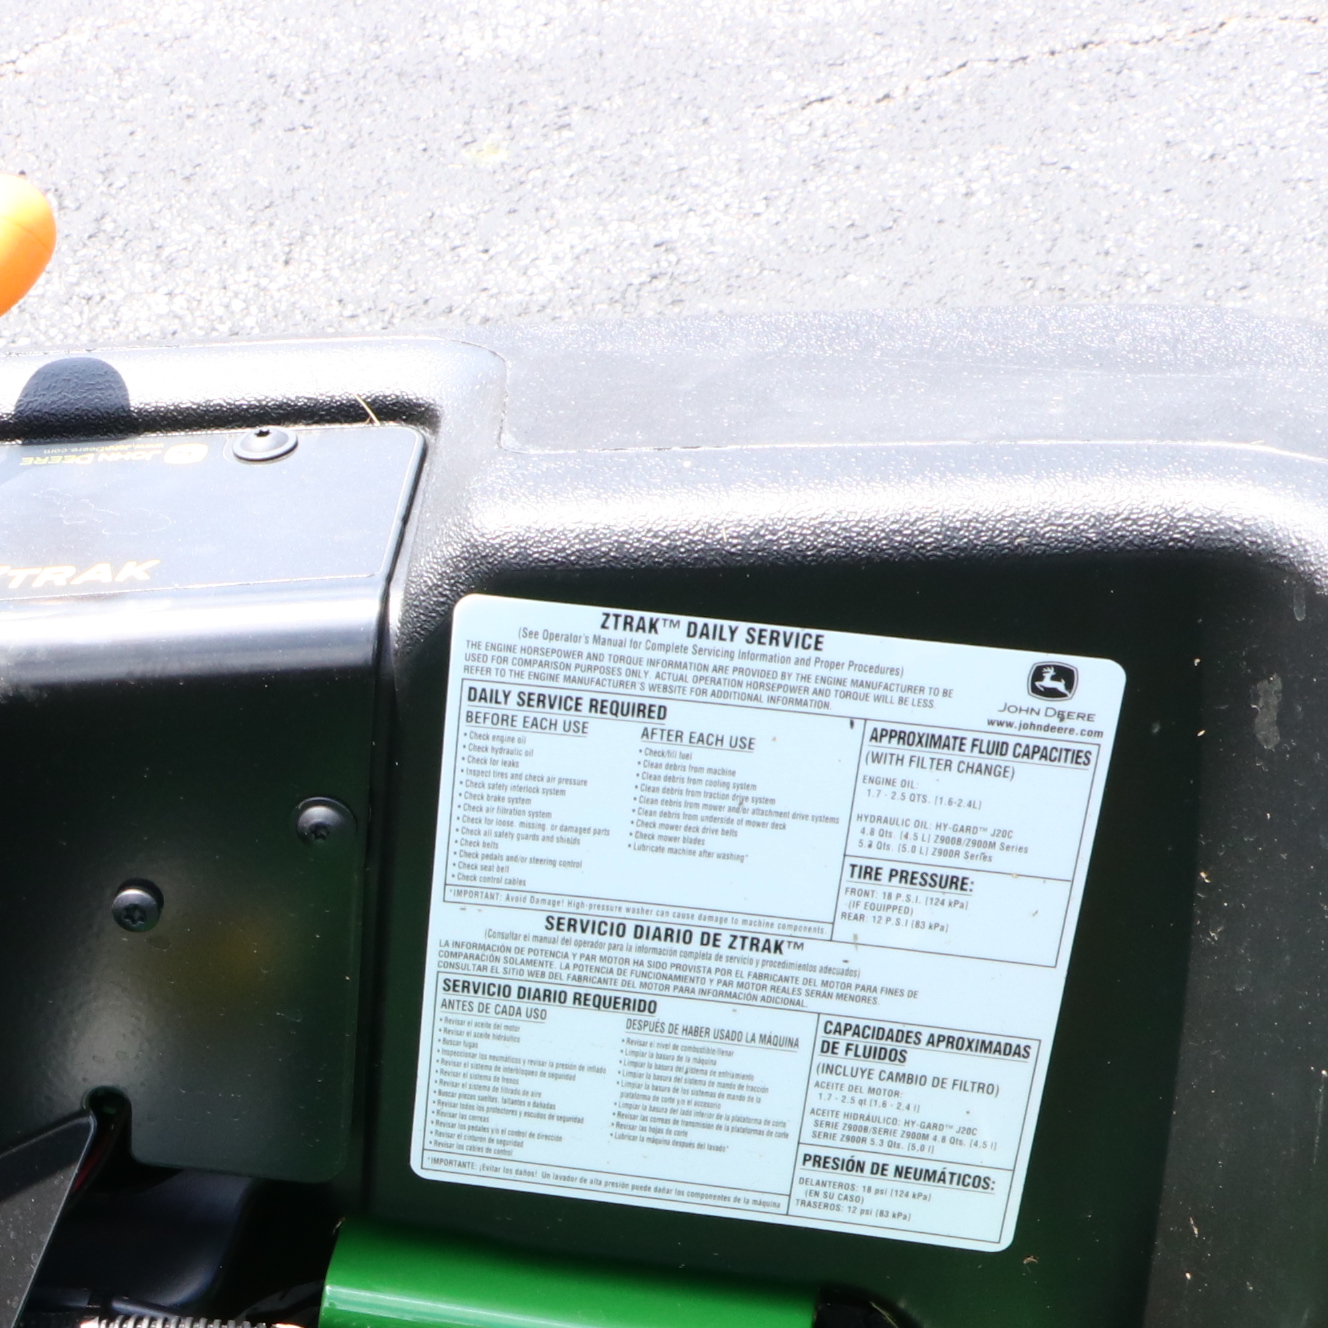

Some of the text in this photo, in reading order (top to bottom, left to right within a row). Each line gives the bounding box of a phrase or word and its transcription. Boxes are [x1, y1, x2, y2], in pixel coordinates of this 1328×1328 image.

[19, 450, 163, 466] JOHN DEERE
[600, 612, 824, 651] ZTRAK™ DAILY SERVICE
[467, 686, 667, 720] DAILY SERVICE REQUIRED
[998, 702, 1095, 722] JOHN DEERE
[465, 710, 588, 734] BEFORE EACH USE
[987, 719, 1104, 738] www.johndeere.com
[469, 730, 526, 744] Check engine oil
[640, 726, 755, 750] AFTER EACH USE
[869, 727, 1092, 766] APPROXIMATE FLUID CAPACITIES
[861, 774, 919, 789] ENGINE OIL:
[463, 790, 532, 805] Check brake system
[849, 863, 973, 892] TIRE PRESSURE:
[544, 915, 804, 955] SERVICIO DIARIO DE ZTRAK™
[820, 1039, 907, 1063] DE FLUIDOS
[823, 1020, 1031, 1059] CAPACIDADES APROXIMADAS
[802, 1153, 995, 1190] PRESIÓN DE NEUMÁTICOS:
